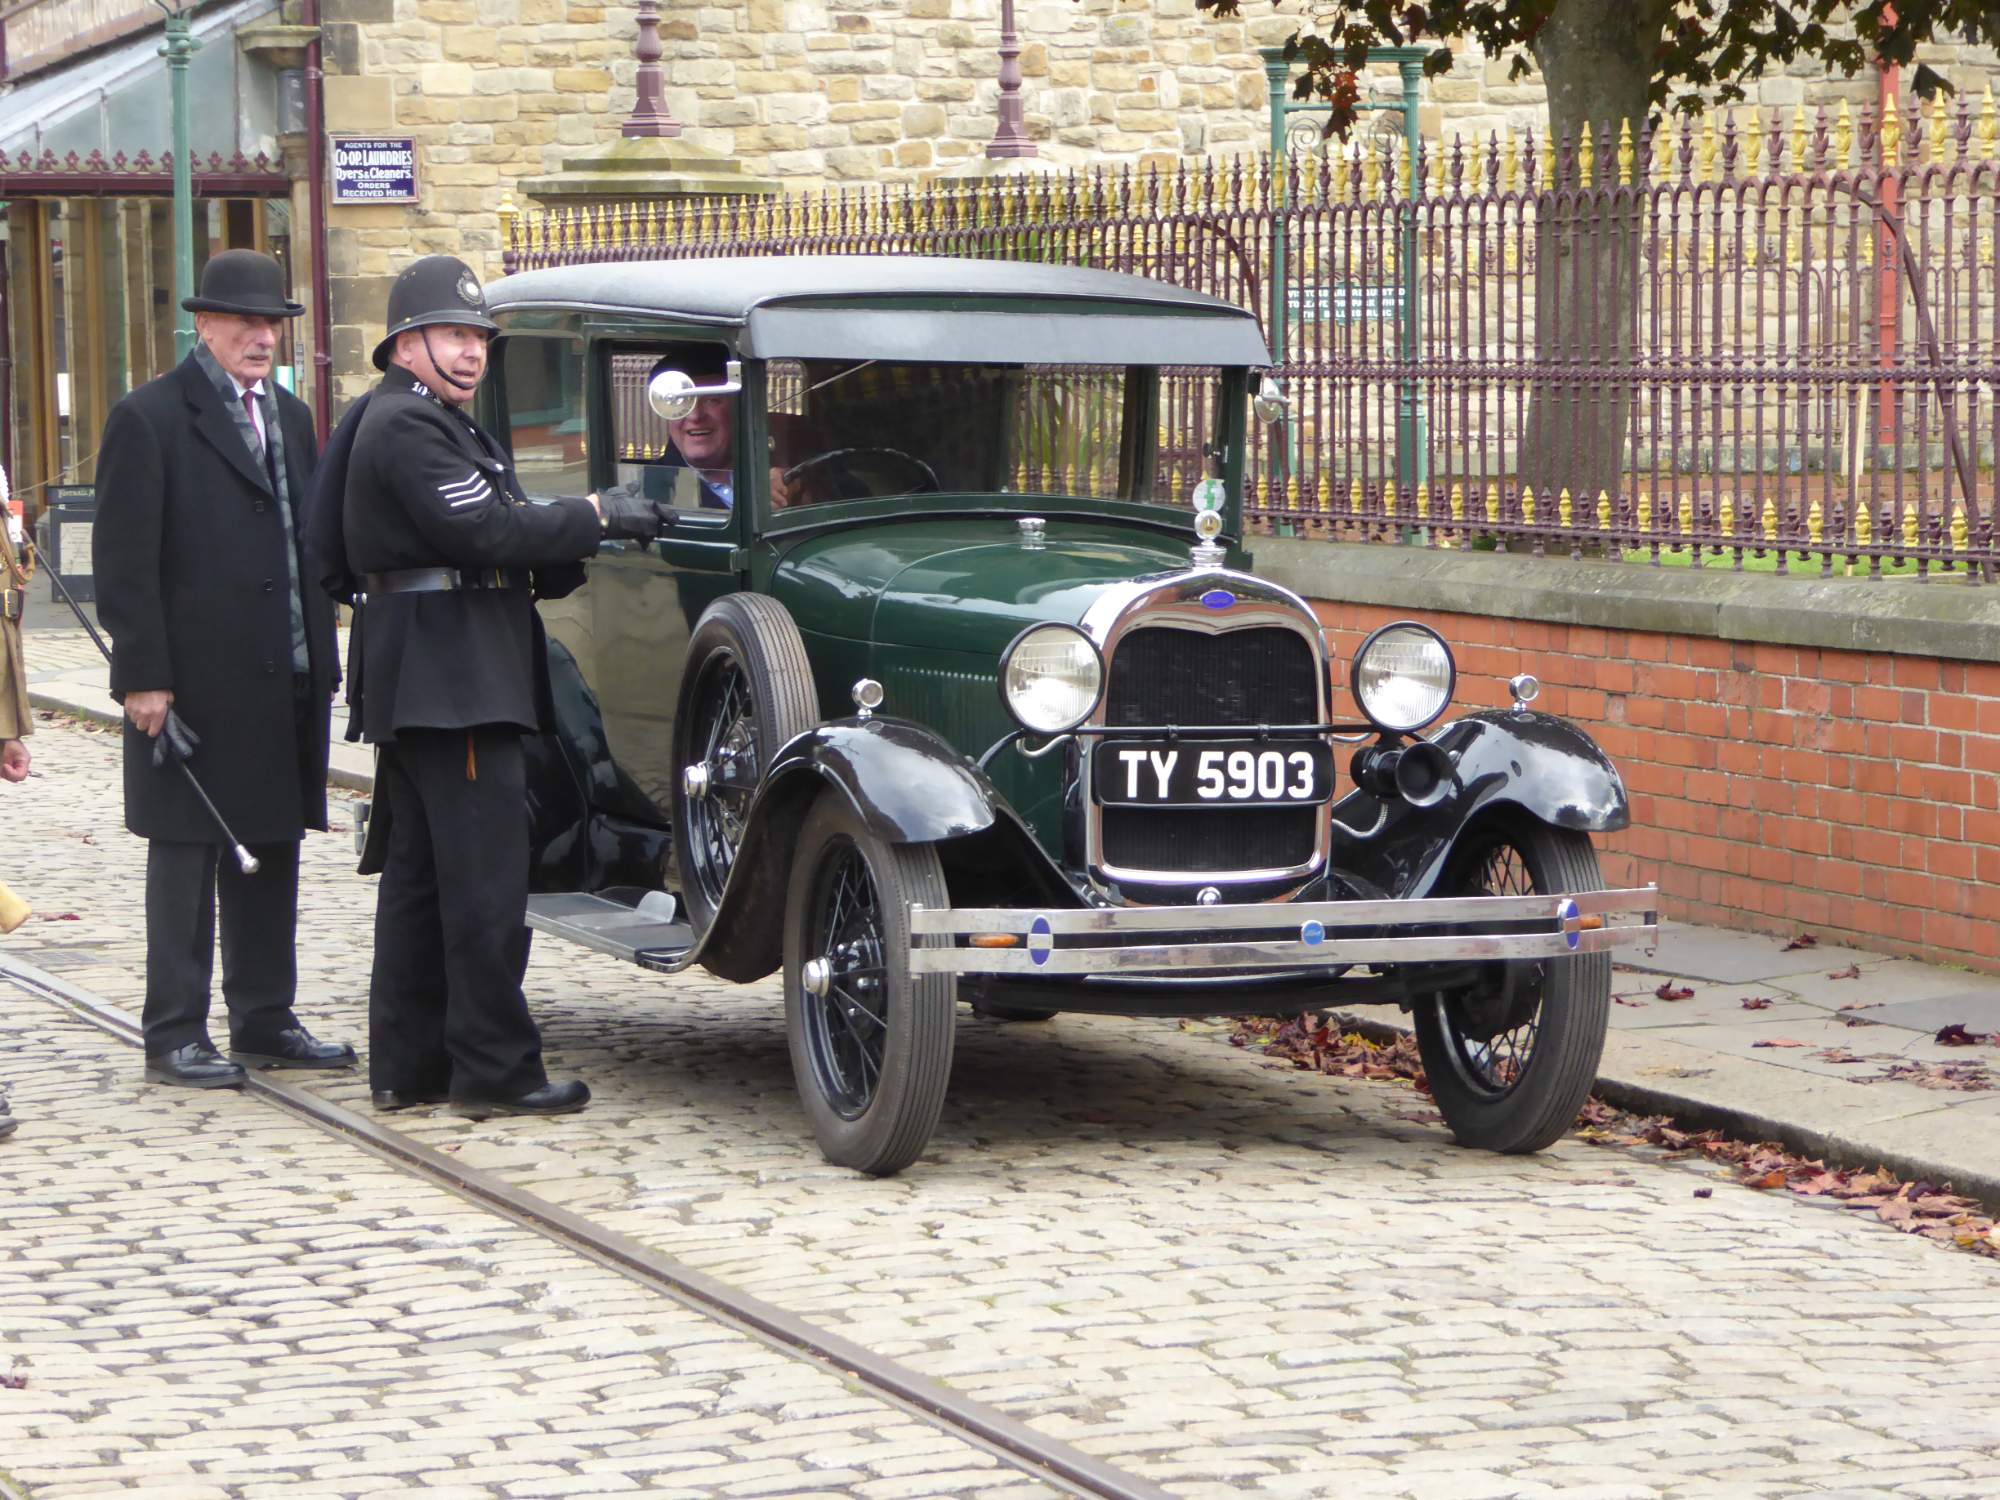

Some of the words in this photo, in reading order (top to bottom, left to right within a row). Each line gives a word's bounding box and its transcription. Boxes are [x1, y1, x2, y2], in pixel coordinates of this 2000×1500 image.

[362, 149, 413, 167] LAUNDRIES
[336, 167, 363, 181] Dyers
[342, 189, 384, 197] RECEIVED
[386, 189, 408, 197] HERE
[1288, 300, 1300, 308] TO
[1119, 751, 1178, 798] TY
[1197, 751, 1314, 799] 5903
